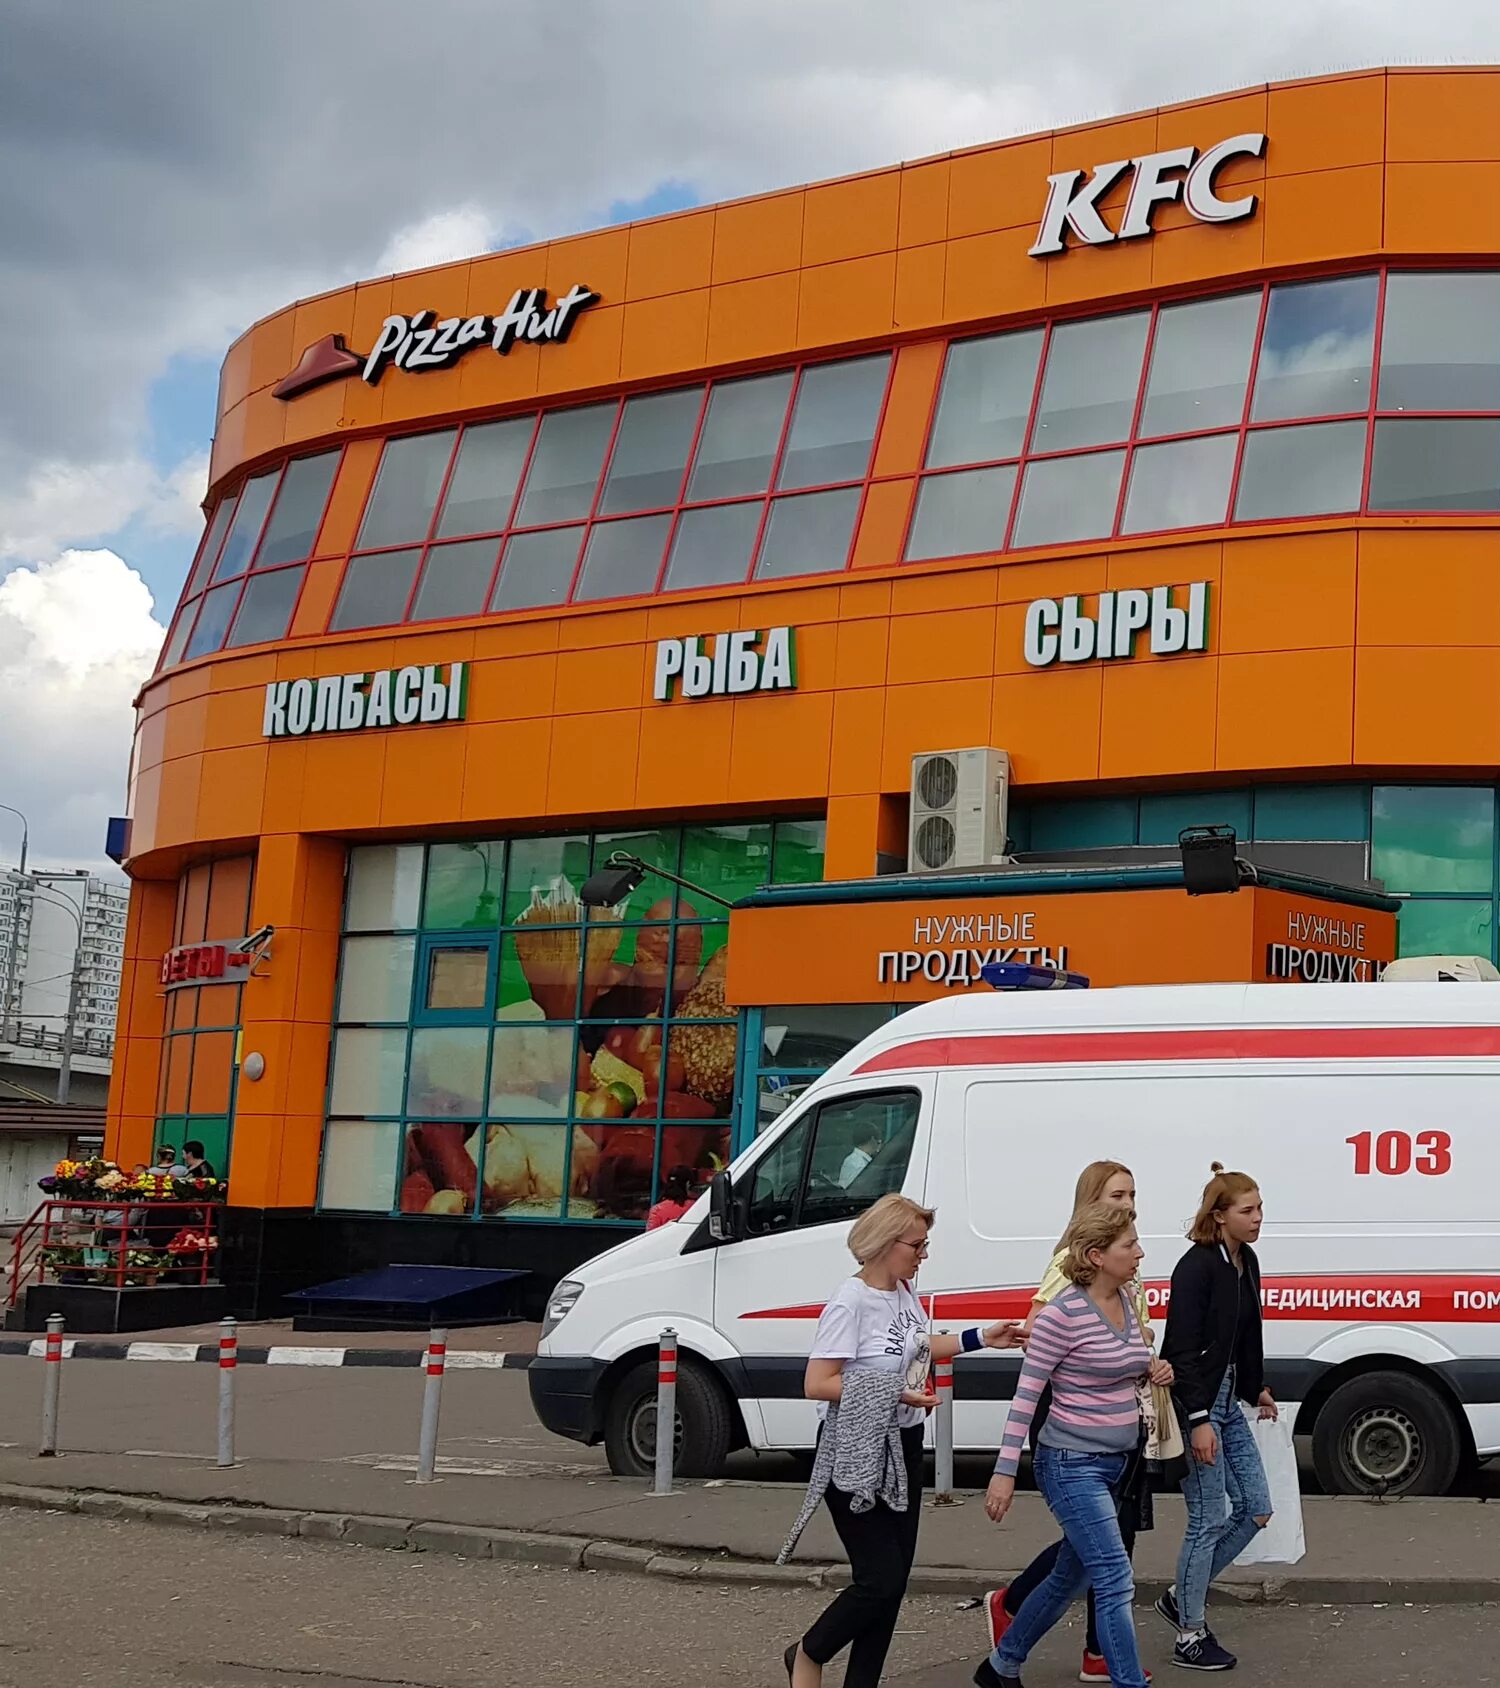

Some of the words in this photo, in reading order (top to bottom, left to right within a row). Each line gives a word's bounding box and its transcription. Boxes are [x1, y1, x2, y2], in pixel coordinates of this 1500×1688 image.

[1027, 132, 1267, 258] KFC
[361, 310, 487, 384] Pizza
[491, 284, 597, 353] Hut
[1024, 581, 1208, 667] СЫРЫ
[262, 661, 467, 737] КОЛБАСЫ
[653, 626, 795, 700] РЫБА
[160, 945, 225, 984] ВЕТЫ
[914, 912, 1035, 944] НУЖНЫЕ
[1287, 911, 1366, 951] НУЖНЫЕ
[1345, 1130, 1452, 1176] 103
